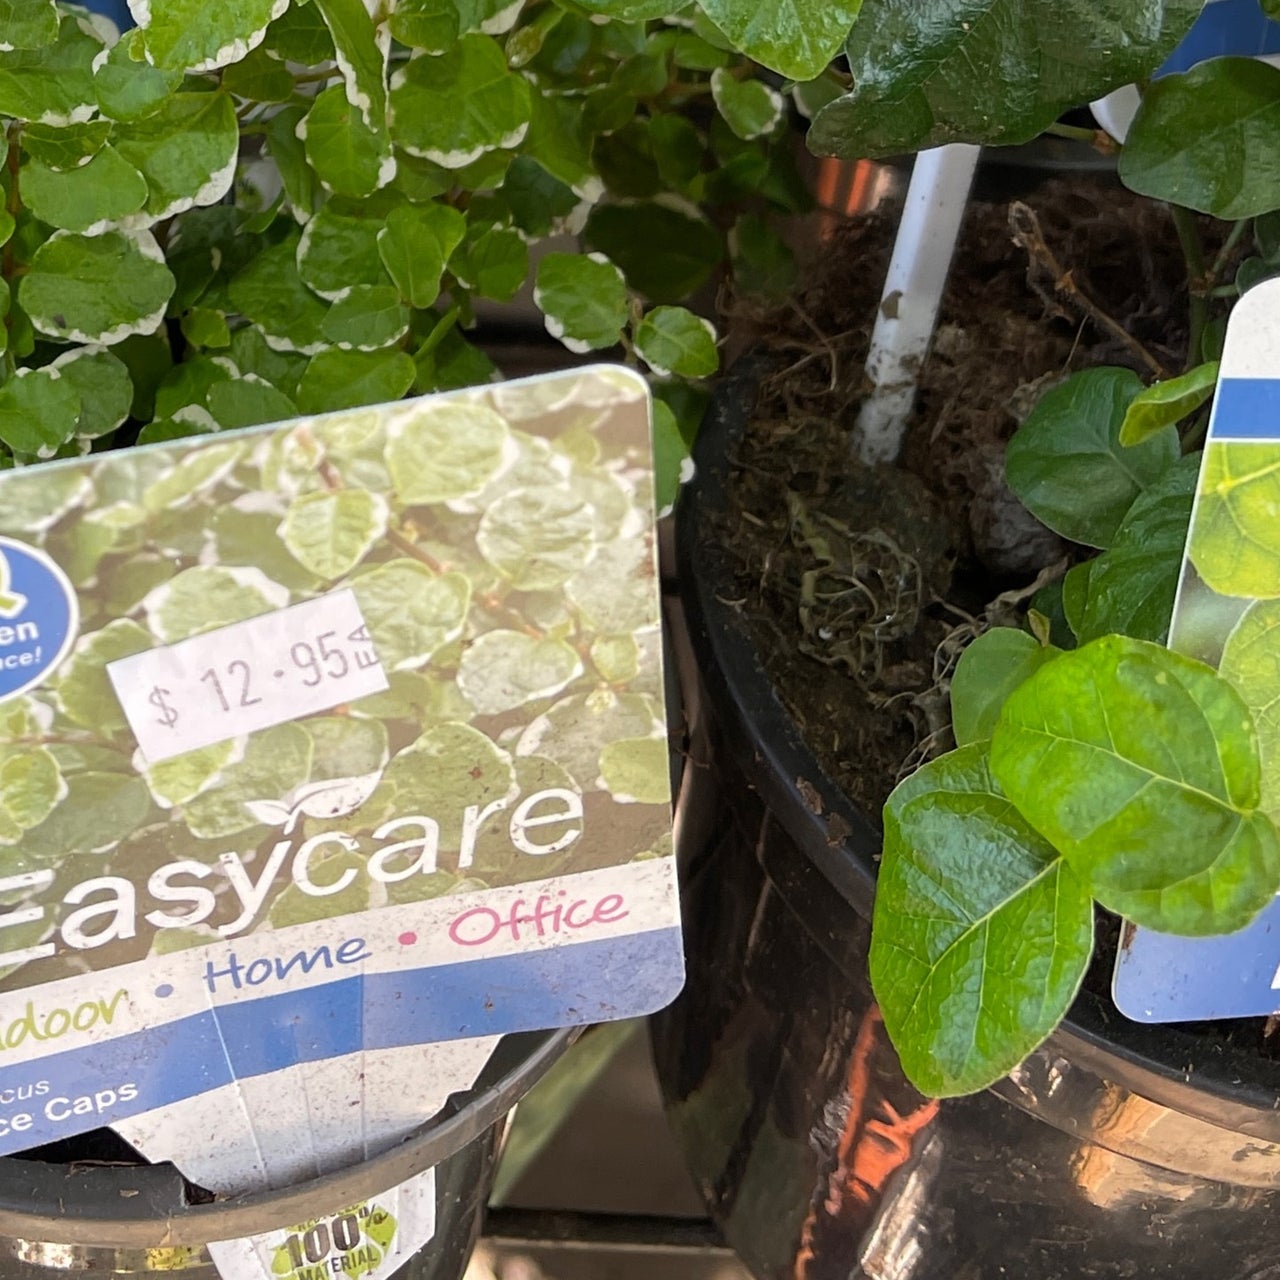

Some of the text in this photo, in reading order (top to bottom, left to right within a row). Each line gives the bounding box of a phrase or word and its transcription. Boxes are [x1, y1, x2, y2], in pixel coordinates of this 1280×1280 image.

[148, 685, 179, 728] $
[202, 936, 373, 993] Home
[449, 890, 630, 947] Office
[43, 1082, 139, 1122] Caps
[281, 1204, 388, 1269] 100%
[297, 1245, 378, 1280] MATERIAL
